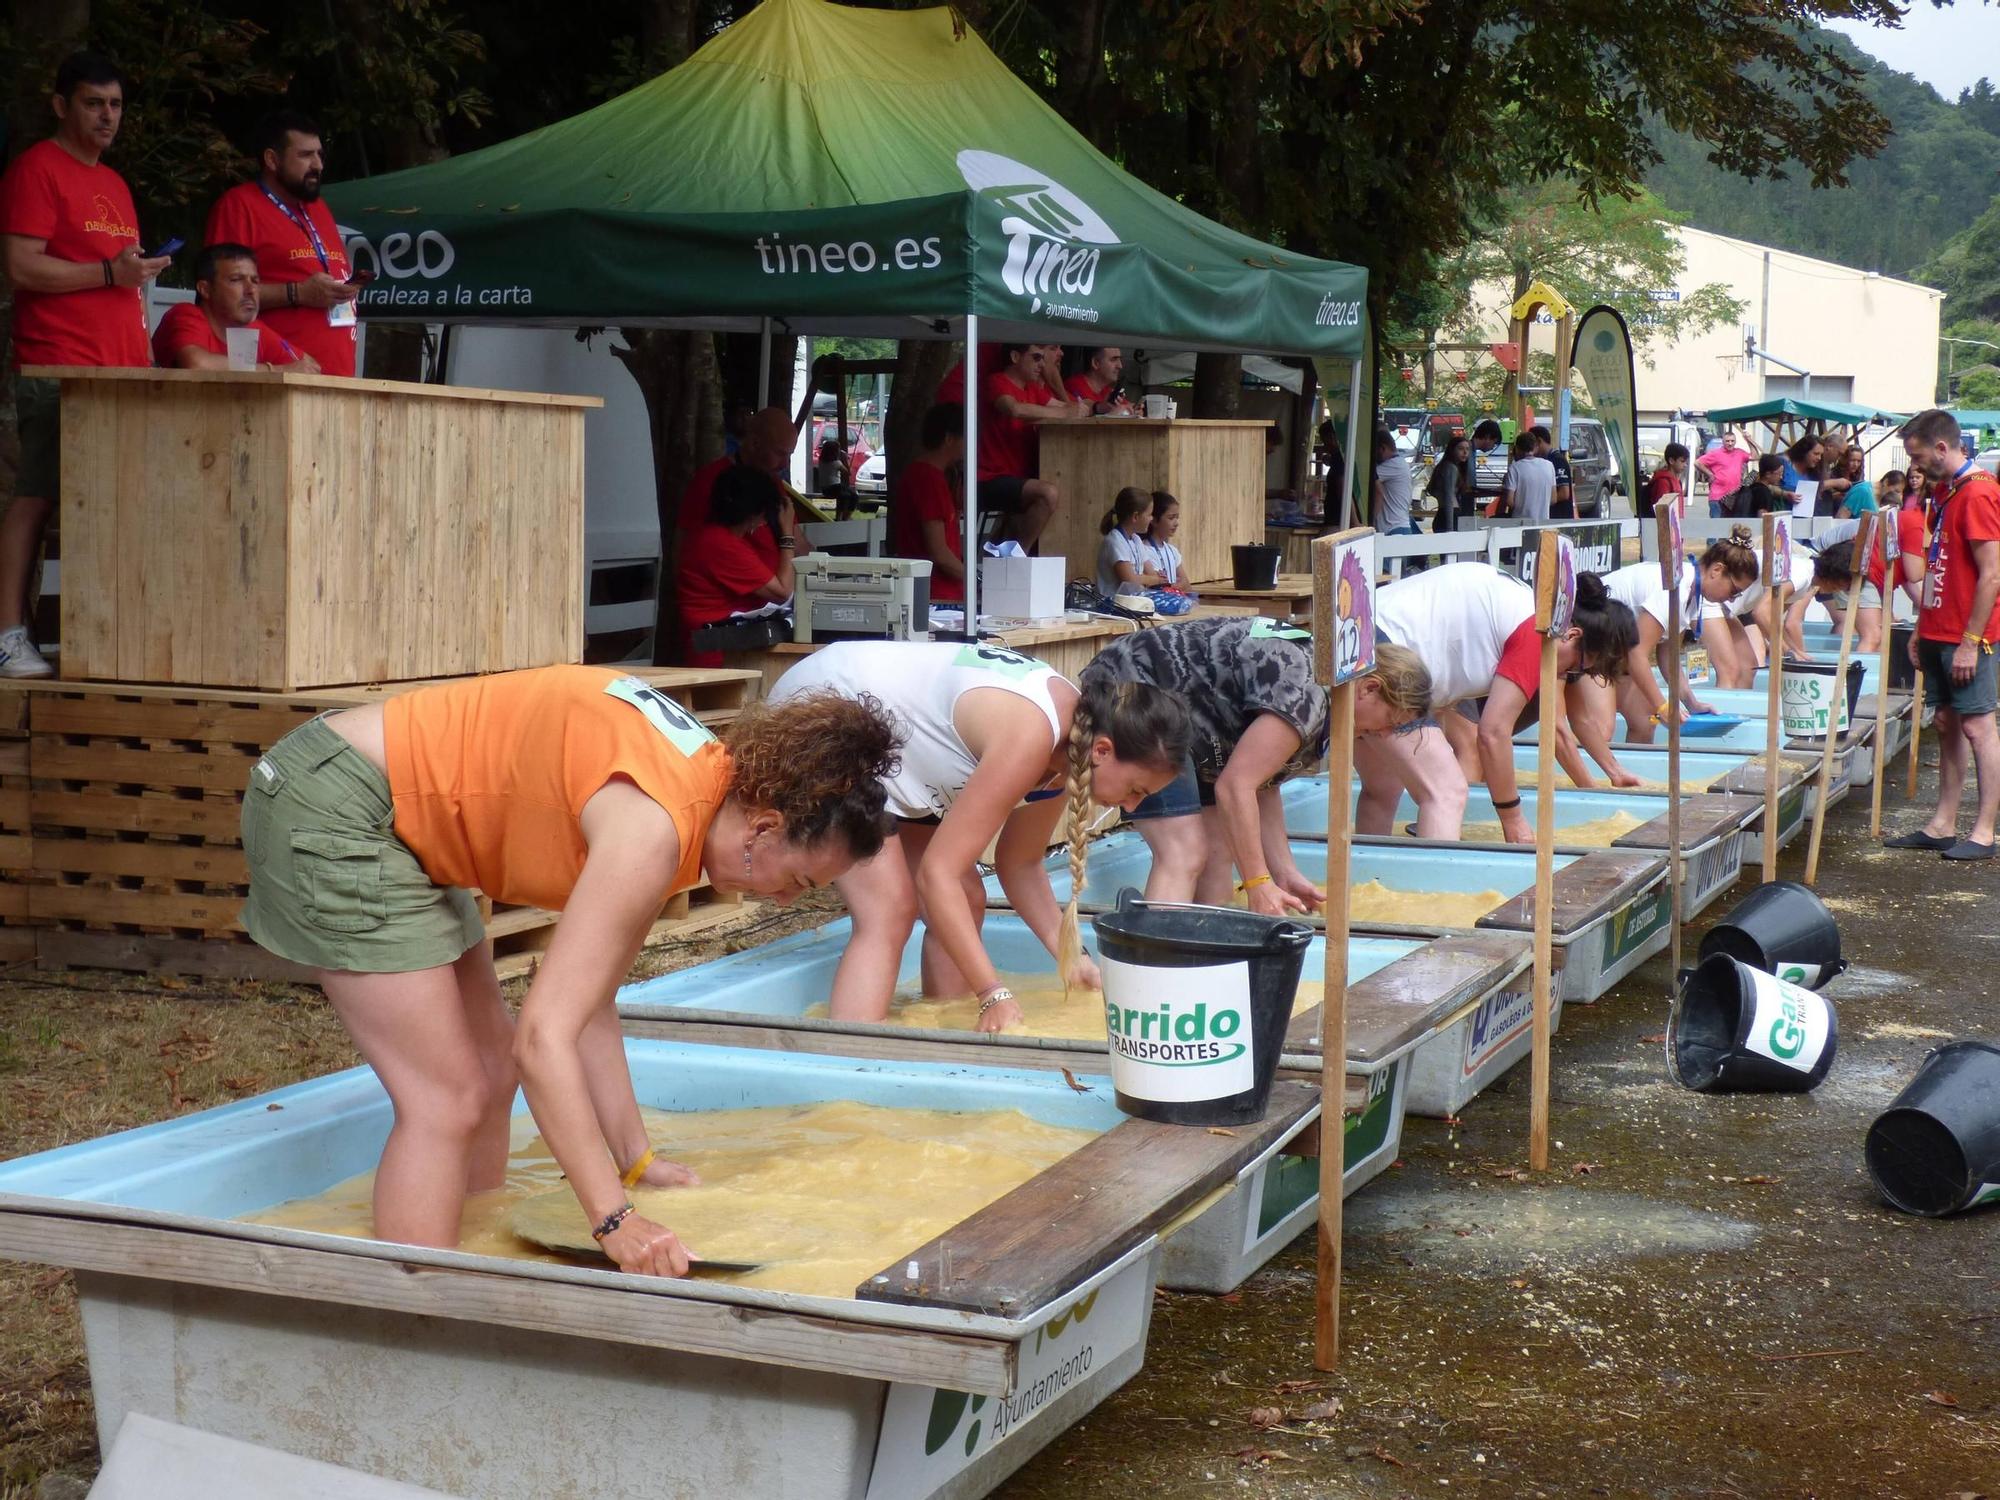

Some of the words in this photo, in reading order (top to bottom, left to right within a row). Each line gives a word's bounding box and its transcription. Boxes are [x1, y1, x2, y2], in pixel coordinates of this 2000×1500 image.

[345, 229, 456, 281] neo
[753, 232, 942, 274] tineo.es
[1001, 216, 1101, 296] Tineo
[356, 284, 429, 305] uraleza
[435, 289, 448, 305] a
[454, 283, 473, 305] la
[478, 285, 533, 305] carta
[1045, 302, 1099, 323] ayuntamiento
[1315, 291, 1361, 326] tineo.es
[1338, 627, 1358, 667] 12
[1107, 1002, 1241, 1042] arrido
[1110, 1032, 1220, 1061] TRANSPORTES
[991, 1345, 1093, 1440] Ayuntamiento
